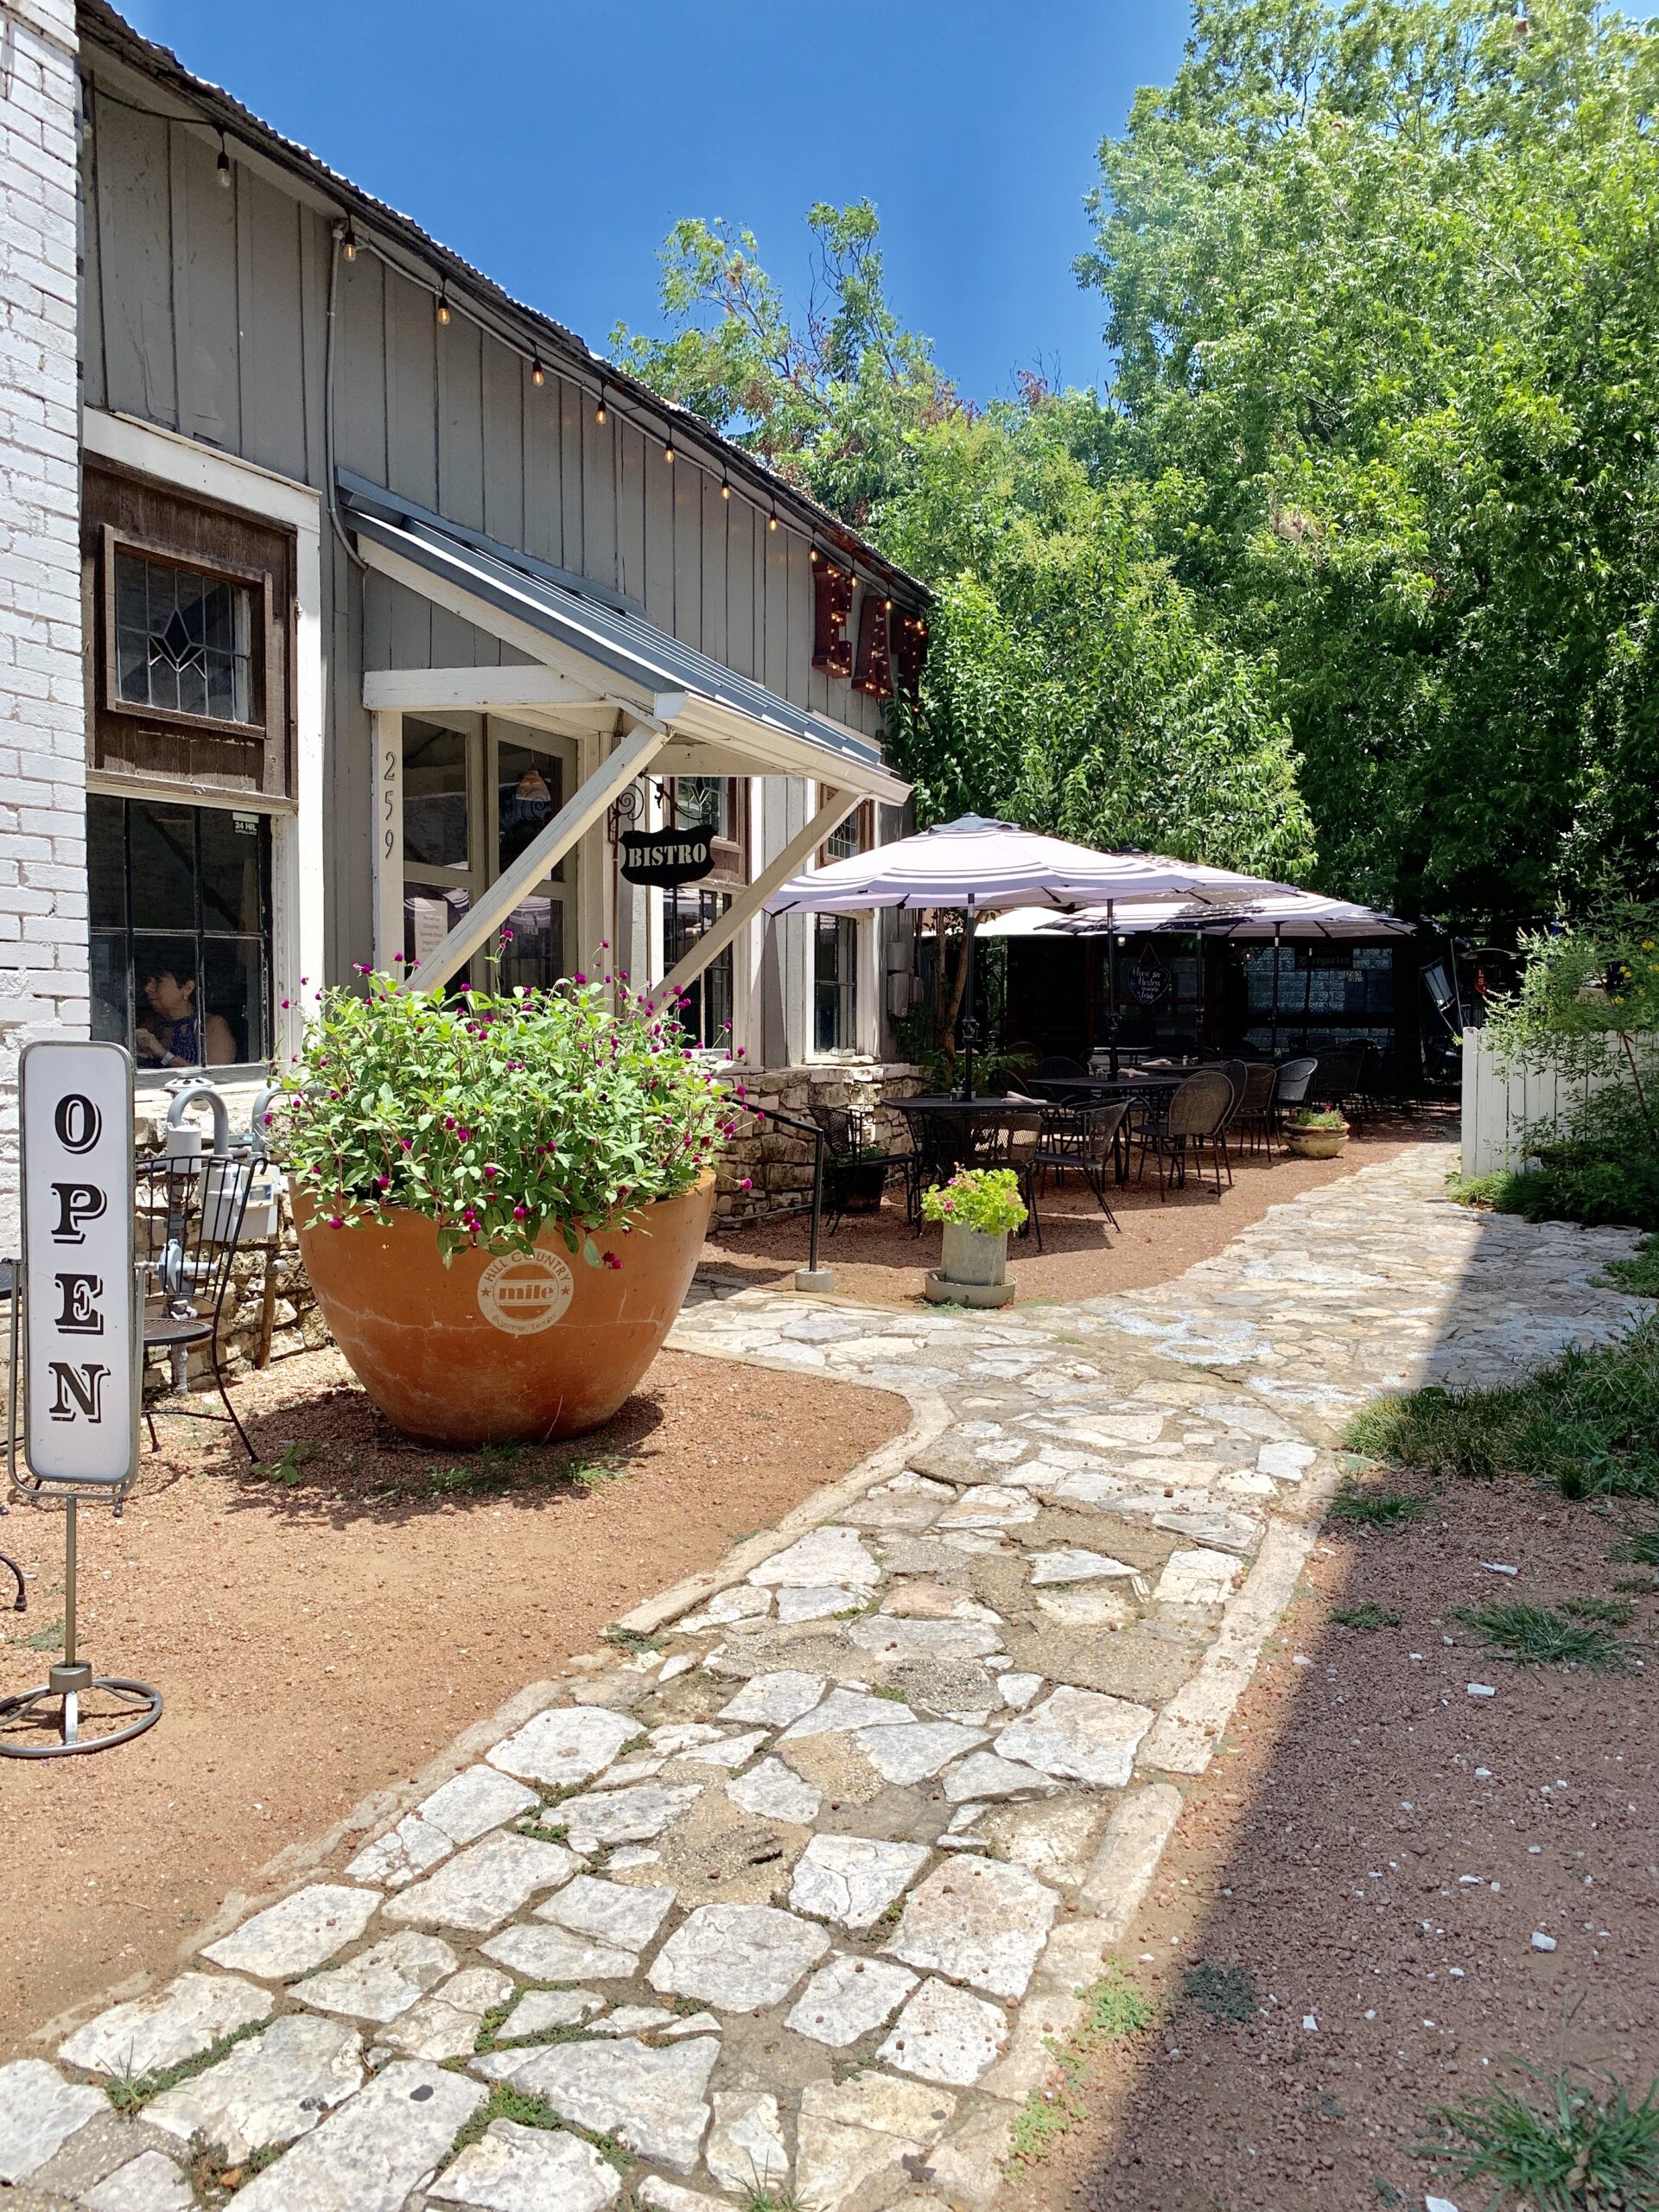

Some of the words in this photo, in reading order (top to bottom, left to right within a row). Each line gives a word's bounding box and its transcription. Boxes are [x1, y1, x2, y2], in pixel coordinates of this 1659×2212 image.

[384, 751, 395, 859] 259
[628, 843, 707, 868] BISTRO
[523, 925, 538, 935] OPEN
[48, 1094, 110, 1423] OPEN
[484, 1259, 508, 1281] HILL
[499, 1285, 554, 1300] mile
[531, 1313, 556, 1331] Texas
